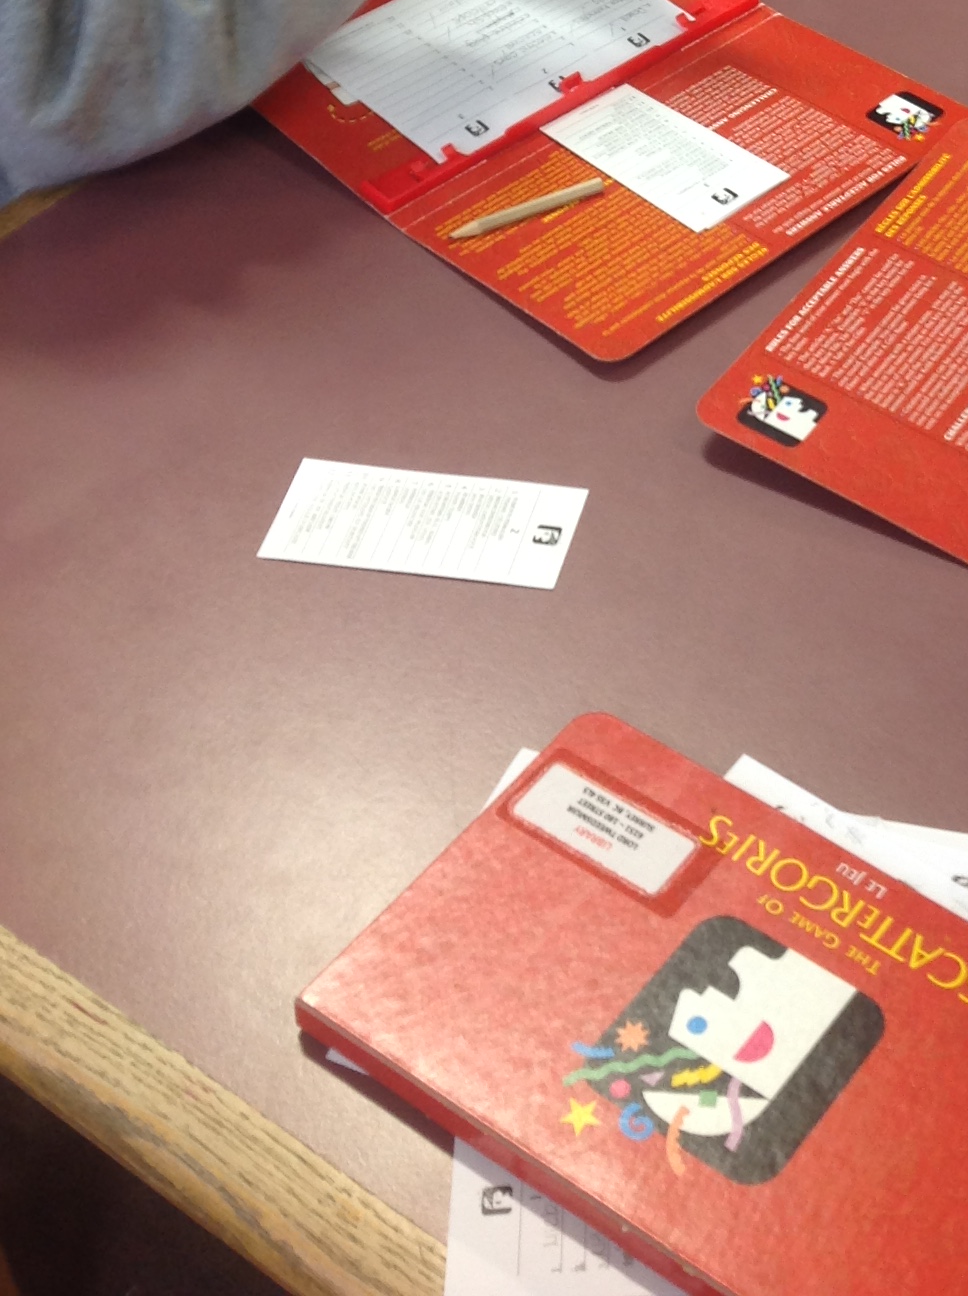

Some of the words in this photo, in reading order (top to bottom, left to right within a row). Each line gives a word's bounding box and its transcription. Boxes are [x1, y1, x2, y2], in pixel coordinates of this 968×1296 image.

[707, 116, 729, 132] ANSW
[764, 328, 788, 353] RULES
[785, 313, 802, 331] FOR
[798, 274, 838, 317] ACCEPTABLE
[834, 245, 865, 278] ANSWERS
[576, 798, 604, 816] STREET
[575, 825, 613, 851] LIBRARY
[616, 834, 639, 851] LORD
[836, 862, 866, 886] JEU
[866, 881, 889, 900] LE
[756, 893, 785, 916] OF
[788, 911, 841, 950] GAME
[845, 944, 881, 977] THE
